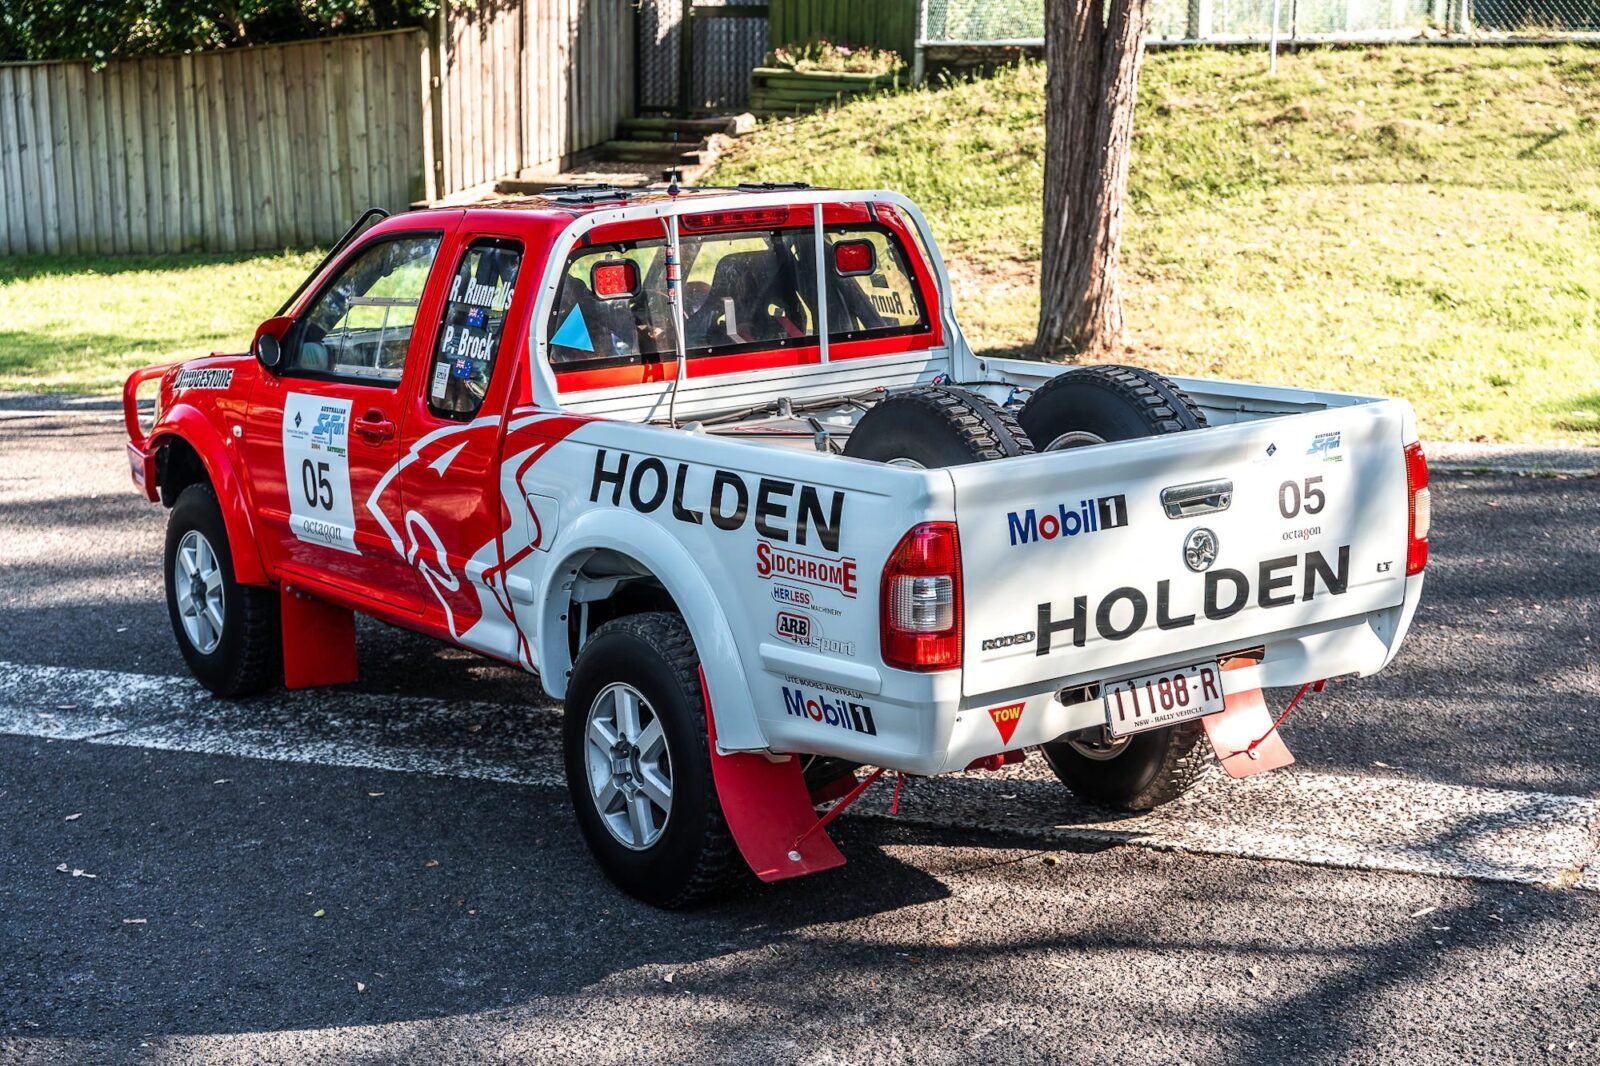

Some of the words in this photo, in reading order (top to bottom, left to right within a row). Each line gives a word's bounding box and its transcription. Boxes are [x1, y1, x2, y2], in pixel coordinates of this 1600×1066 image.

[449, 274, 462, 302] R.
[464, 277, 515, 311] Runnalls
[442, 326, 455, 354] P.
[457, 328, 495, 361] Brock
[173, 368, 234, 390] BRIDGESTONE
[302, 458, 333, 511] 05
[589, 449, 845, 552] HOLDEN
[1279, 475, 1326, 519] 05
[303, 519, 342, 543] octagon
[1007, 499, 1098, 546] Mobil
[1282, 525, 1321, 541] octagon
[756, 543, 857, 593] SIDCHROME
[773, 586, 810, 605] HERLESS
[1035, 545, 1350, 657] HOLDEN
[810, 604, 842, 617] MACHINERY
[779, 616, 807, 637] ARB
[981, 631, 1036, 652] RODEO
[825, 684, 864, 701] AUSTRALIA
[782, 686, 852, 730] Mobil
[993, 706, 1021, 723] TOW
[1134, 718, 1150, 728] NSW
[1154, 712, 1175, 723] RALLY
[1176, 706, 1204, 718] VEHICLE
